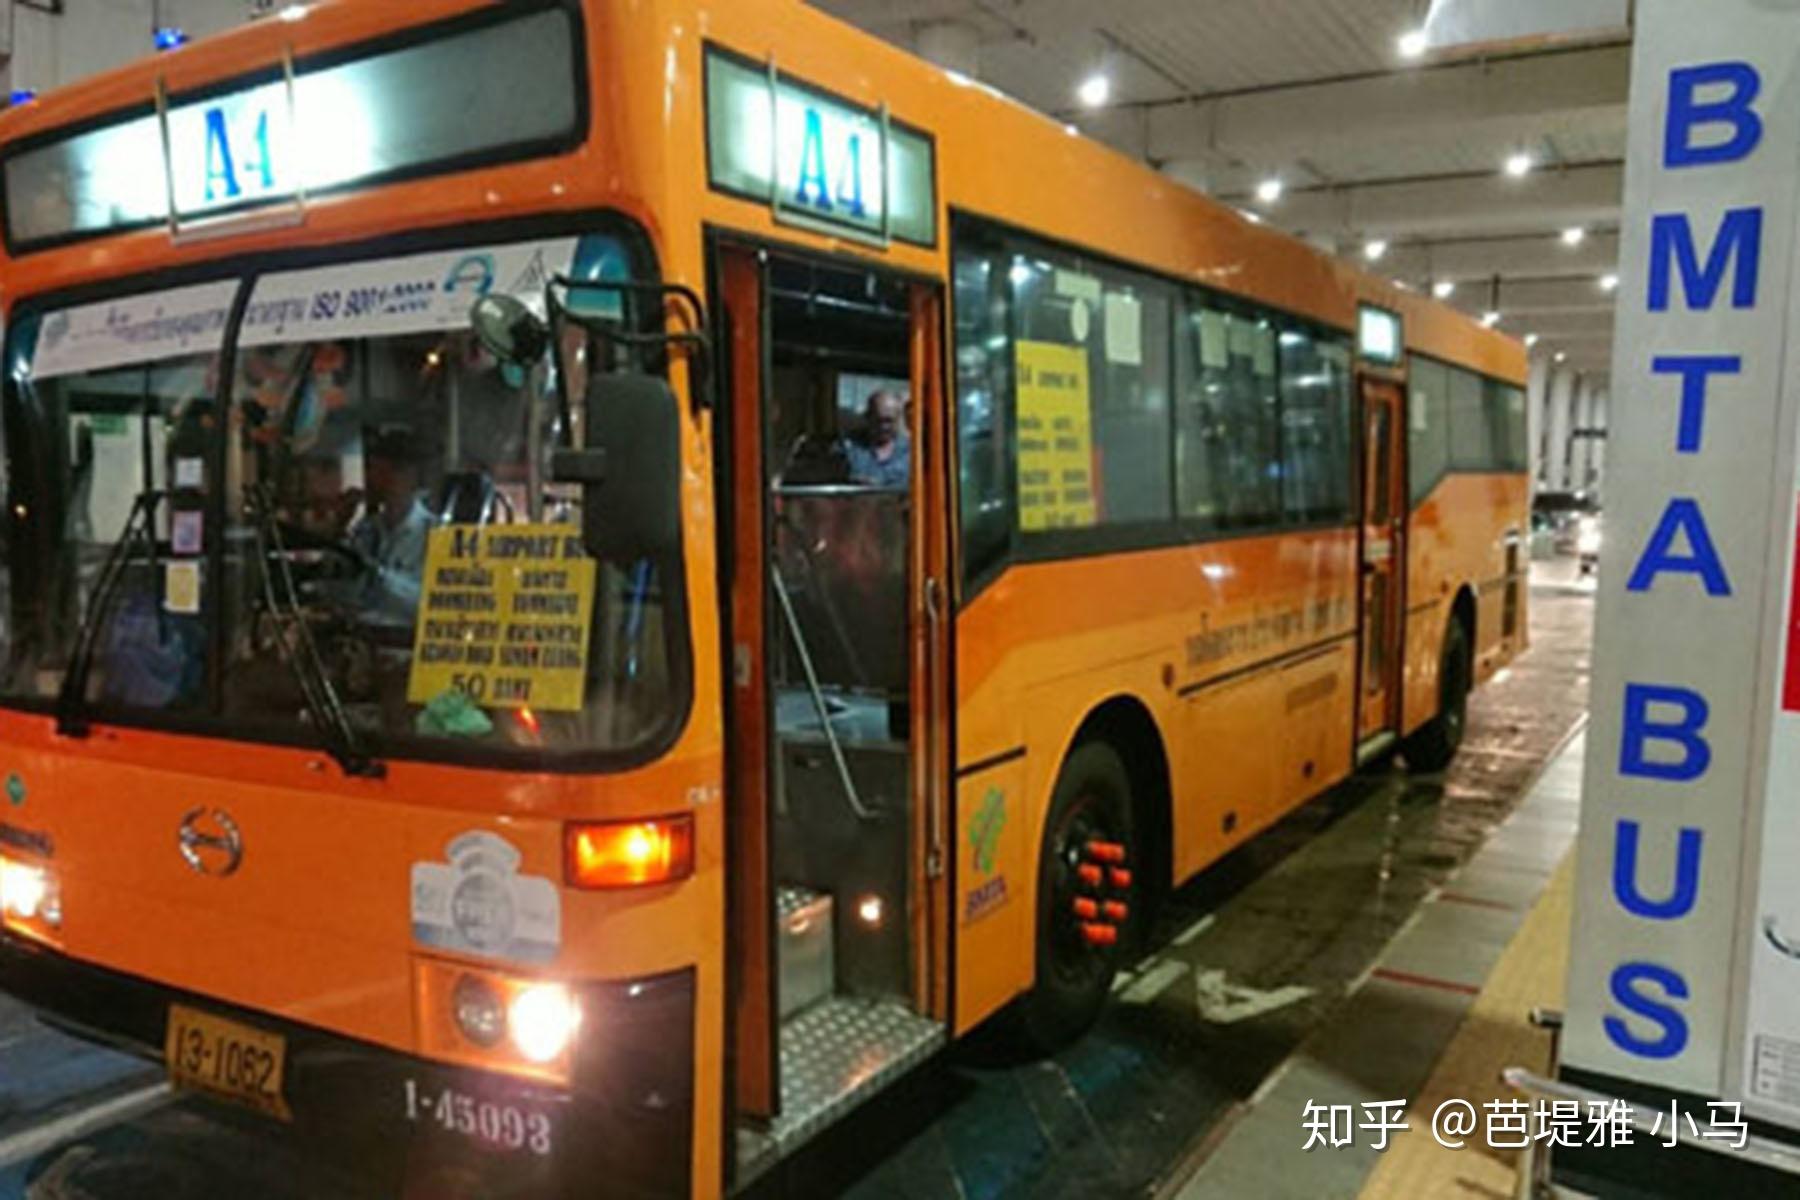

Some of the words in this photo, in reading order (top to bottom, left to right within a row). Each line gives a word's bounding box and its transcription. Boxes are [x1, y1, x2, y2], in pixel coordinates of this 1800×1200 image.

[206, 108, 274, 200] A4
[795, 107, 866, 219] A4
[1626, 62, 1763, 597] BMTA
[1603, 683, 1712, 1060] BUS
